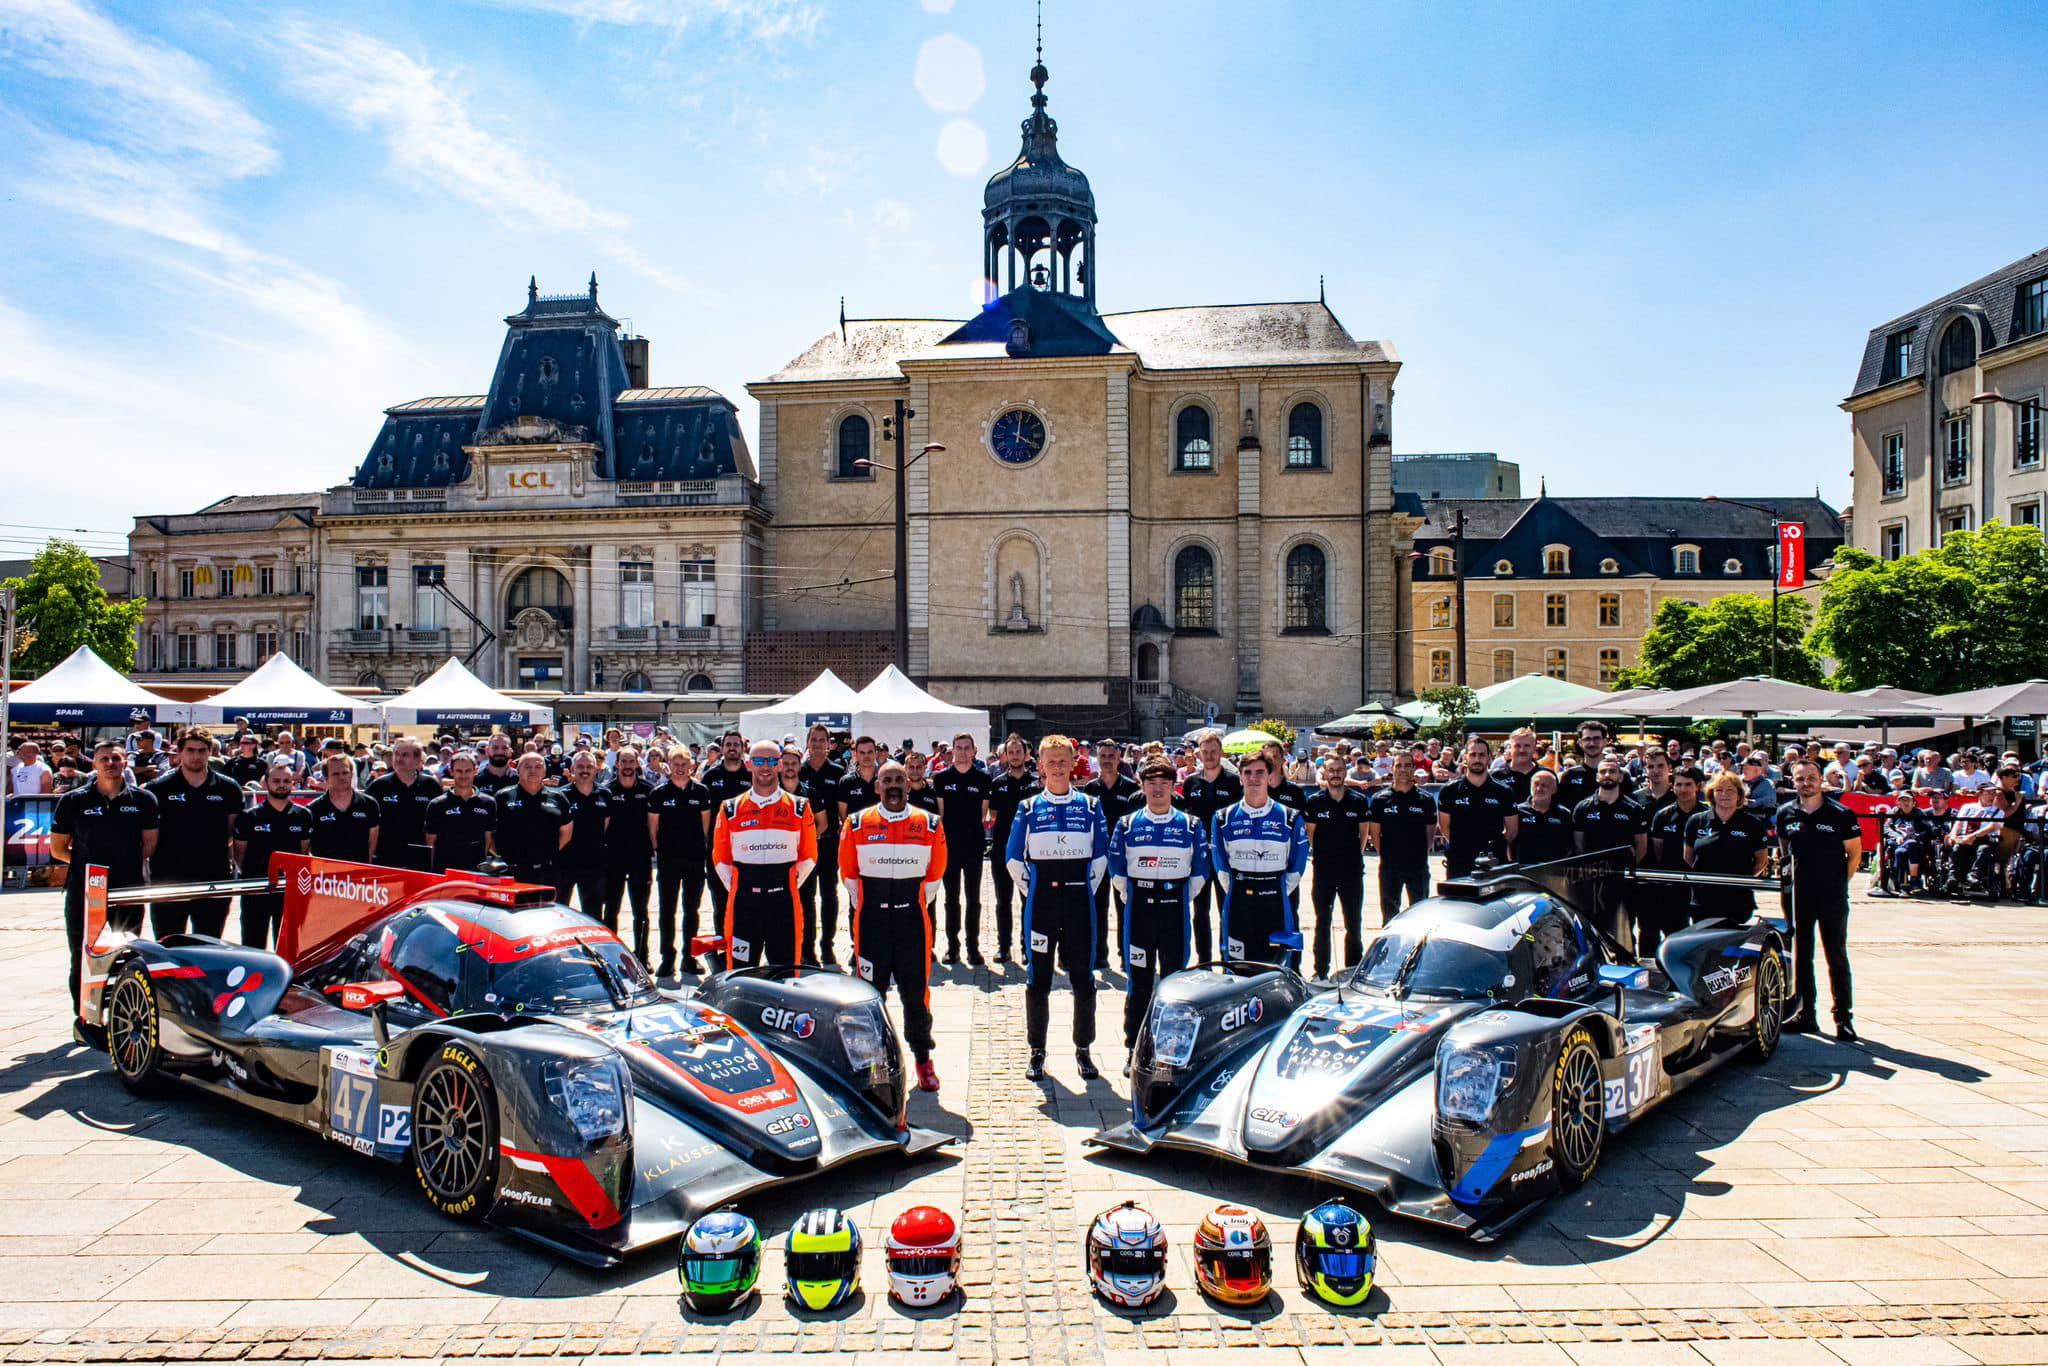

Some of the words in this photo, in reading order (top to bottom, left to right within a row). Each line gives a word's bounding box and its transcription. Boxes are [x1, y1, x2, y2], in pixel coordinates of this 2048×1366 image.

[508, 471, 555, 489] LCL
[55, 708, 85, 716] SPARK
[1816, 824, 1835, 832] COOL
[749, 843, 787, 851] databricks
[1057, 835, 1067, 845] K
[878, 857, 918, 865] databricks
[1040, 848, 1084, 857] KLAUSEN
[313, 871, 389, 906] databricks
[1032, 938, 1047, 946] 37
[1229, 945, 1243, 953] 37
[1130, 952, 1145, 960] 37
[345, 992, 368, 1004] HRX
[761, 1005, 795, 1031] elf
[1220, 1008, 1249, 1032] elf
[443, 1046, 477, 1074] EAGLE
[689, 1048, 759, 1075] WISDOM
[1288, 1042, 1360, 1065] WISDOM
[1291, 1053, 1345, 1071] AUDIO
[709, 1060, 759, 1080] AUDIO
[1629, 1048, 1654, 1108] 37
[333, 1074, 374, 1135] 47
[738, 1093, 768, 1107] COOL
[379, 1103, 412, 1142] P2
[766, 1116, 794, 1136] elf
[1250, 1107, 1284, 1127] elf
[331, 1130, 353, 1147] PRO
[355, 1139, 374, 1154] AM
[500, 1186, 552, 1207] GOODYEAR
